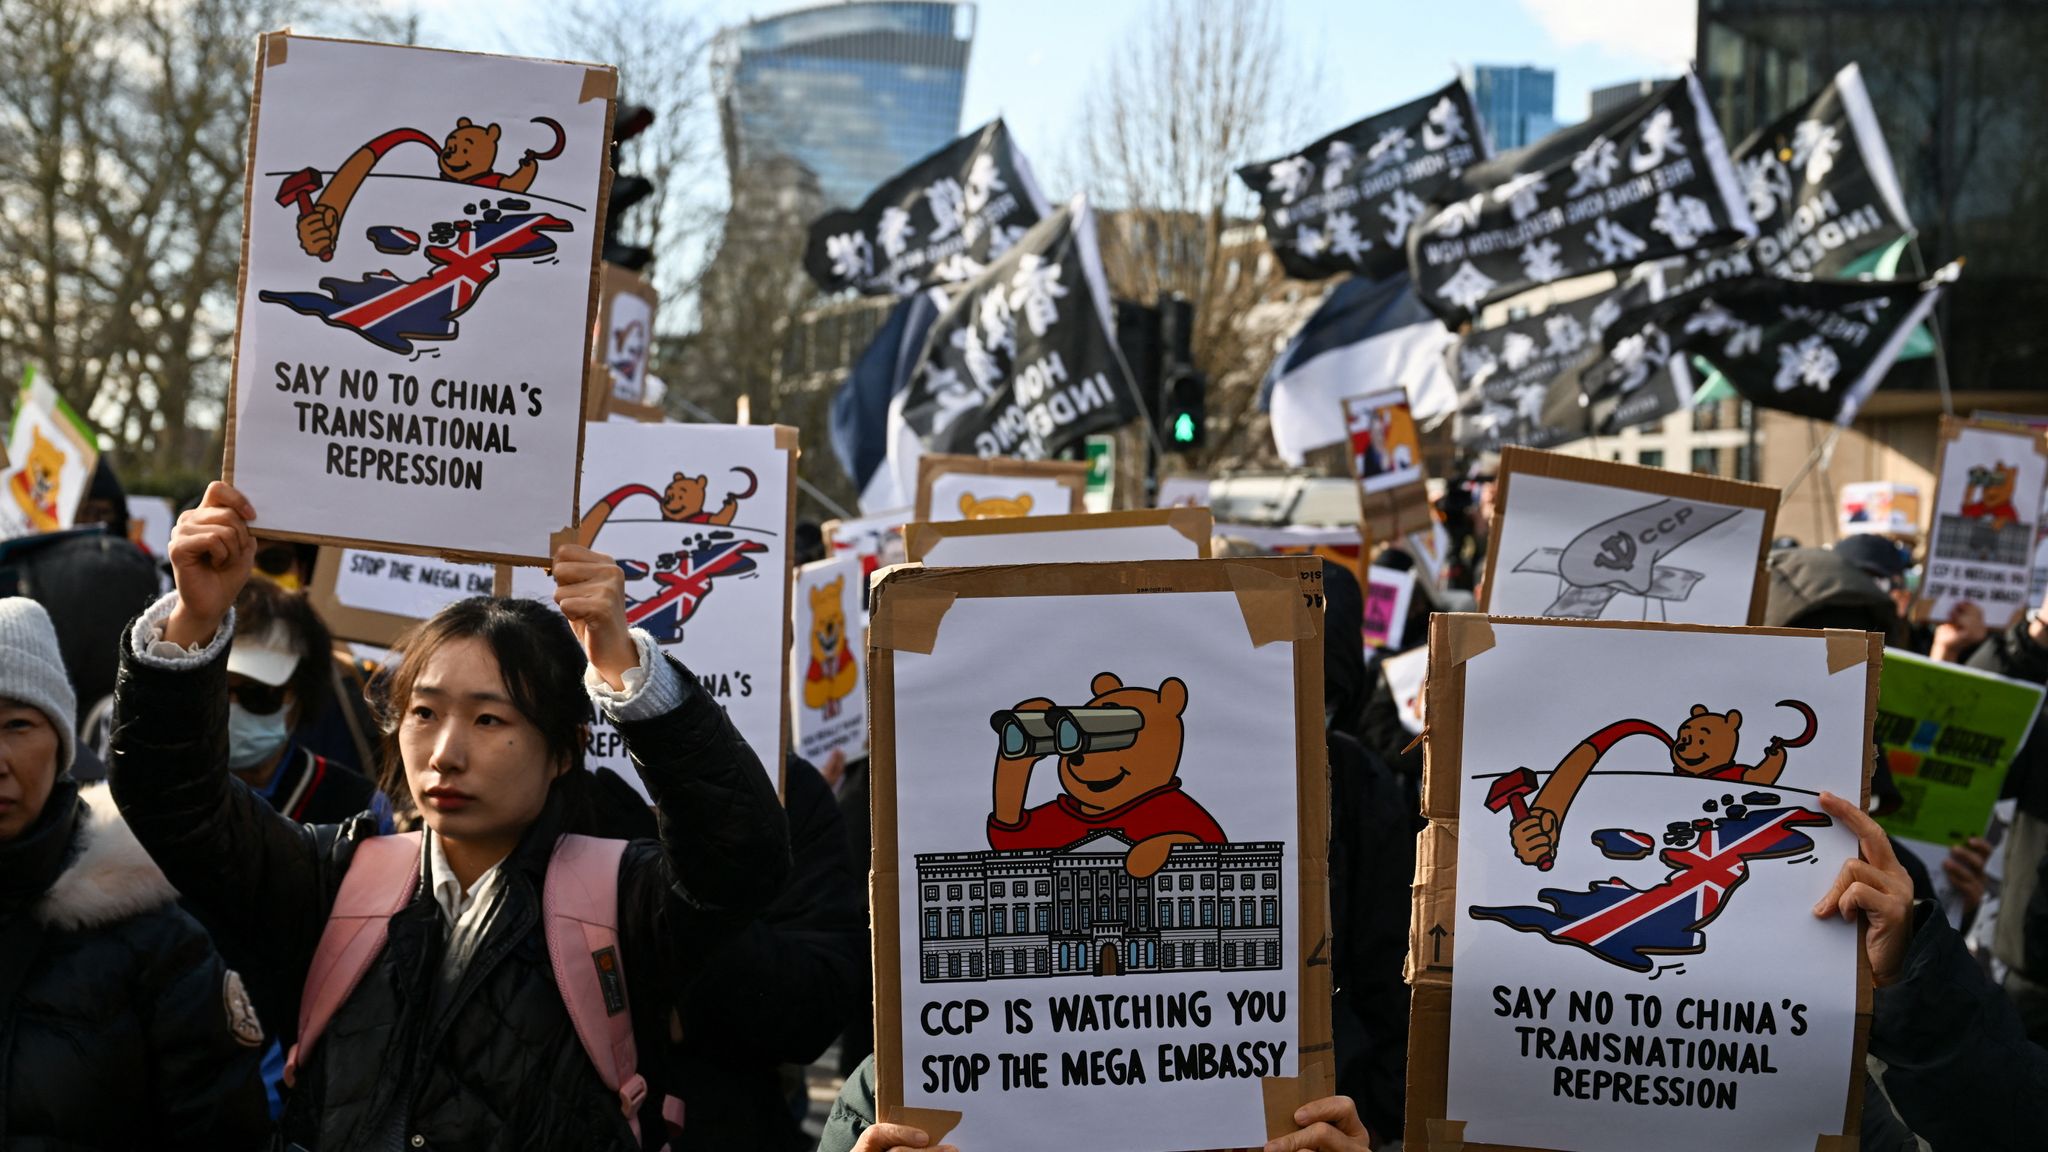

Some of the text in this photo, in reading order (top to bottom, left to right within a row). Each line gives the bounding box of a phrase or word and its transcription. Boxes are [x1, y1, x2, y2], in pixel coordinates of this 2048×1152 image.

[275, 361, 543, 418] SAY NO TO CHINA'S
[293, 400, 518, 455] TRANSNATIONAL
[326, 441, 483, 491] REPRESSION
[1639, 506, 1693, 545] CCP
[351, 554, 386, 576] STOP
[389, 561, 415, 582] THE
[419, 567, 460, 590] MEGA
[697, 670, 752, 698] NA'S
[920, 989, 1287, 1037] CCP IS WATCHING YOU
[1492, 984, 1808, 1037] SAY NO TO CHINA'S
[921, 1040, 1288, 1094] STOP THE MEGA EMBASSY
[1514, 1025, 1779, 1075] TRANSNATIONAL
[1552, 1065, 1738, 1111] REPRESSION
